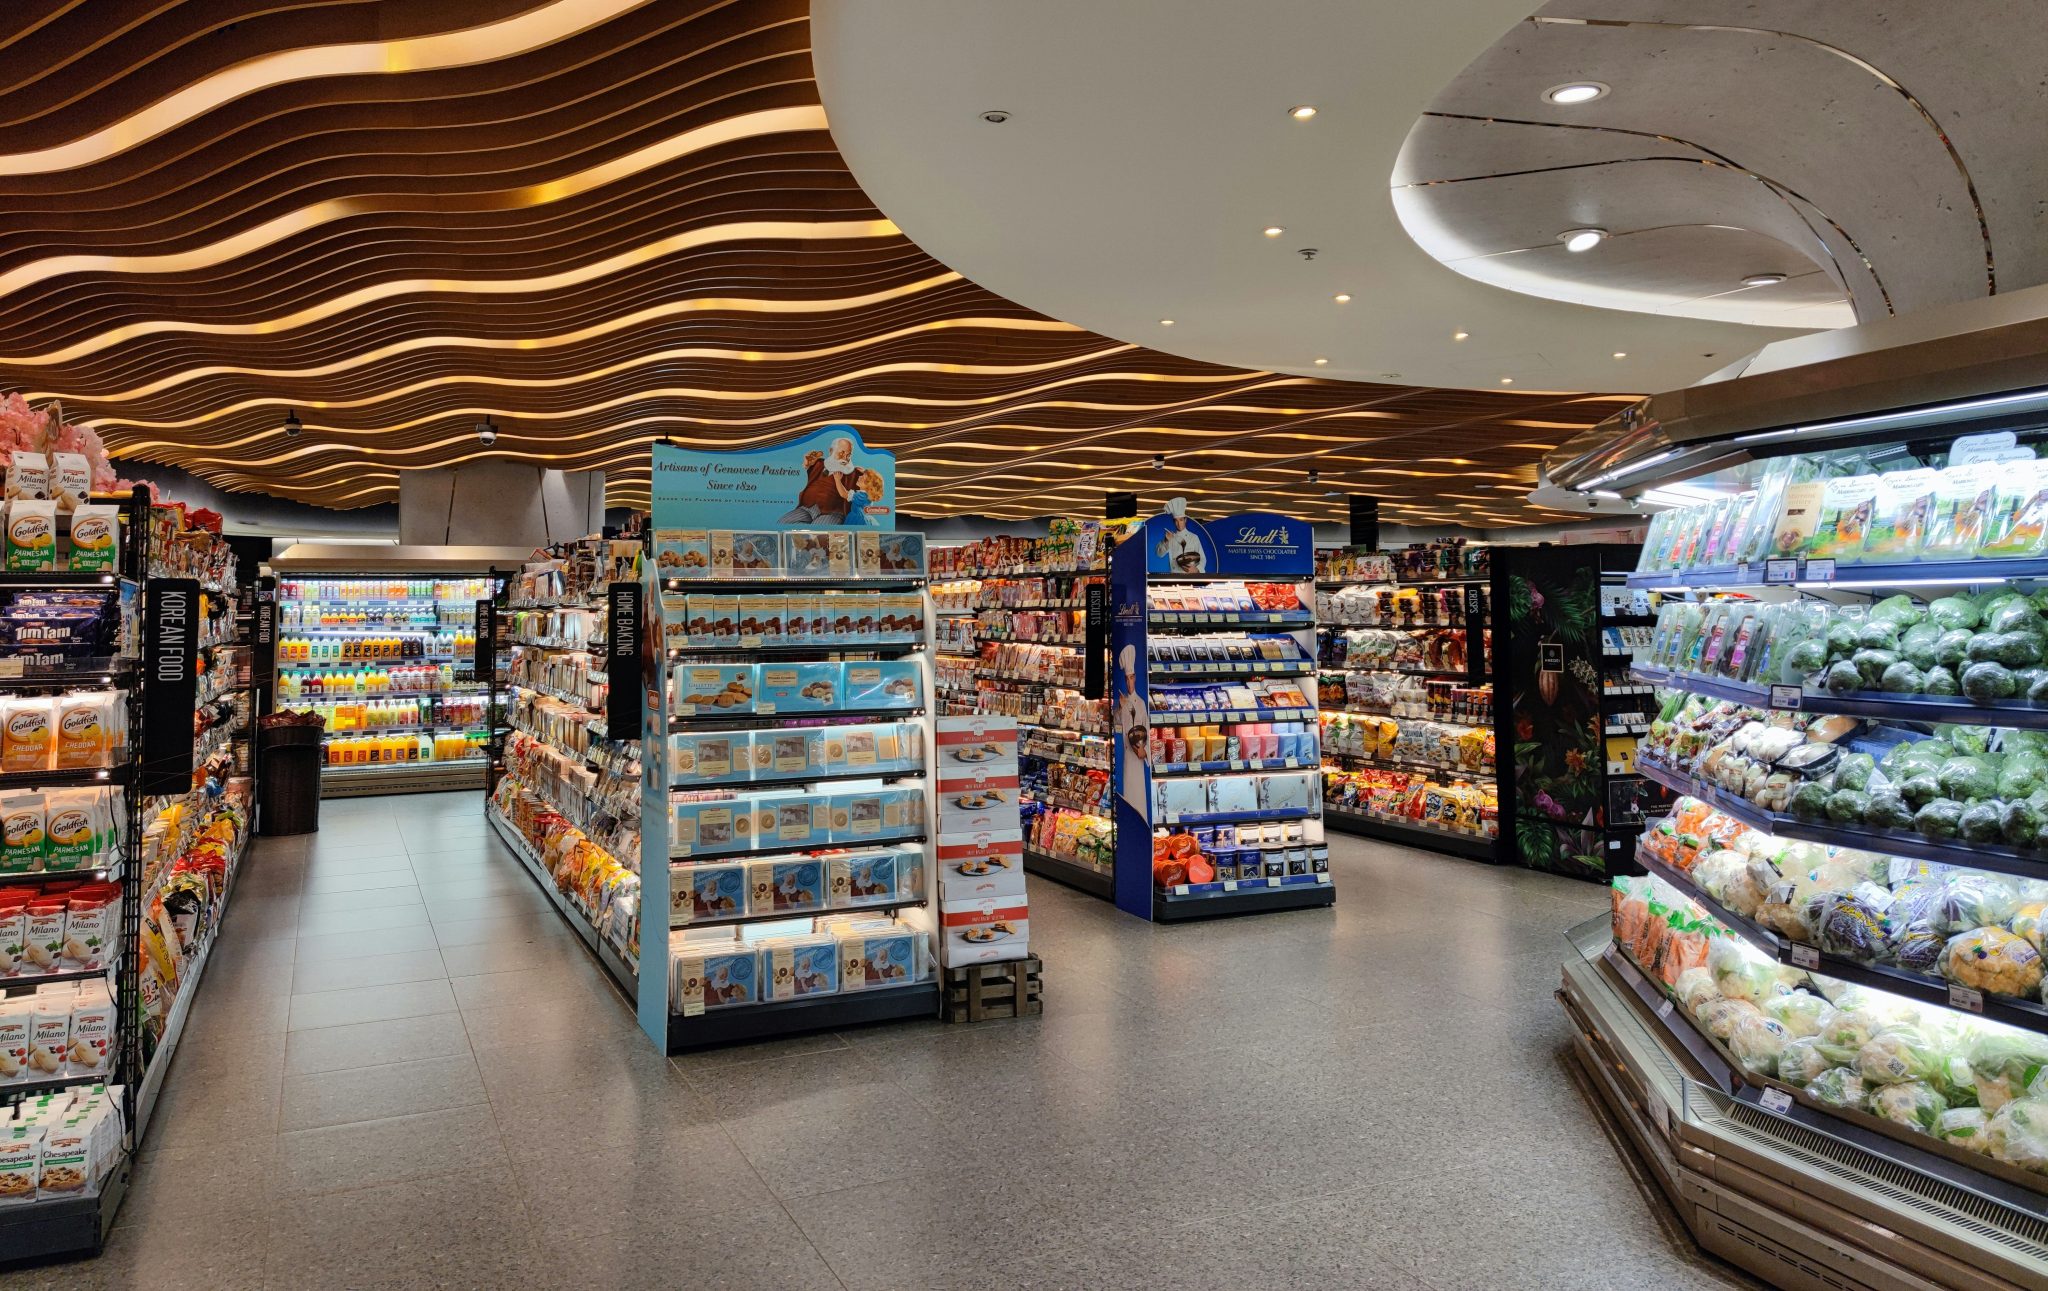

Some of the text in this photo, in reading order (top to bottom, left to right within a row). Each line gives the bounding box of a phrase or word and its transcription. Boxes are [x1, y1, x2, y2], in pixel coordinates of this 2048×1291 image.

[655, 461, 800, 476] Artisans of Genovese Pastries
[17, 475, 47, 484] Milano
[60, 475, 88, 484] Milano
[707, 480, 757, 491] Since 1820
[14, 523, 49, 538] Goldfish
[77, 525, 109, 539] Goldfish
[1235, 527, 1279, 544] Lindt
[76, 550, 109, 558] PARMESAN
[1468, 589, 1479, 614] CRISPS
[1091, 590, 1101, 626] BISCUITS
[260, 605, 271, 628] KOREAN
[616, 591, 634, 656] HOME BAKING
[158, 591, 187, 681] KOREAN FOOD
[11, 717, 46, 732] Goldfish
[64, 714, 98, 729] Goldfish
[12, 744, 44, 752] CHEDDAR
[65, 741, 96, 749] CHEDDAR
[5, 819, 39, 835] Goldfish
[54, 819, 88, 834] Goldfish
[5, 846, 40, 855] PARMESAN
[53, 844, 88, 853] PARMESAN
[28, 926, 59, 935] Milano
[68, 921, 99, 930] Milano
[0, 930, 18, 938] lano
[74, 1024, 107, 1034] Milano
[34, 1031, 66, 1040] Milano
[43, 1148, 87, 1159] Chesapeake
